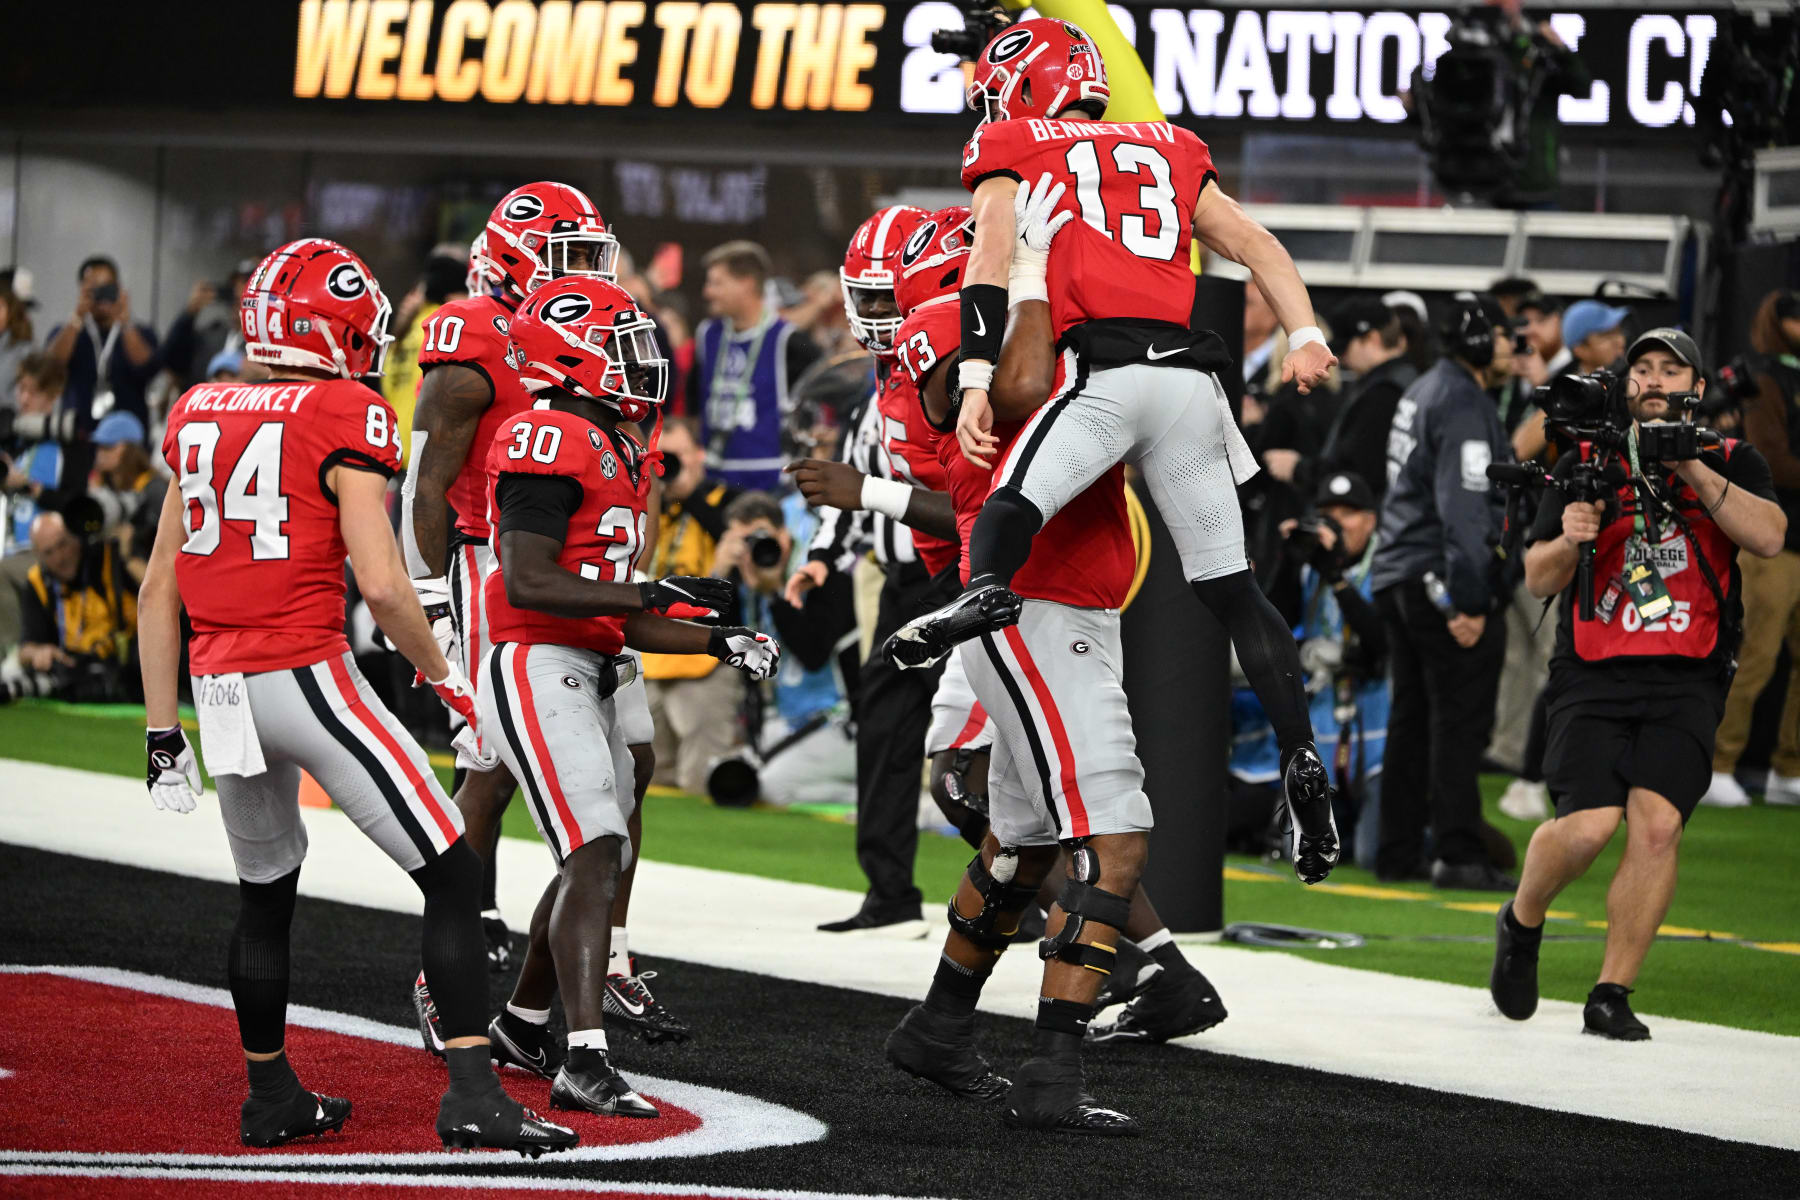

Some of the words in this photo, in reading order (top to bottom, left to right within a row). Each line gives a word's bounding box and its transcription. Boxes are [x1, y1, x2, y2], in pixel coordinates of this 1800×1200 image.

[293, 0, 647, 106] WELCOME
[652, 1, 742, 108] TO
[751, 3, 886, 111] THE
[1150, 9, 1609, 125] NATIOL
[964, 130, 984, 168] 3
[1027, 119, 1142, 142] BENNETT
[1147, 122, 1175, 143] IV
[1065, 140, 1180, 261] 13
[245, 310, 283, 339] 84
[425, 316, 465, 353] 10
[898, 330, 937, 382] 73
[185, 385, 315, 413] McCONKEY
[508, 421, 562, 464] 30
[178, 422, 289, 560] 84
